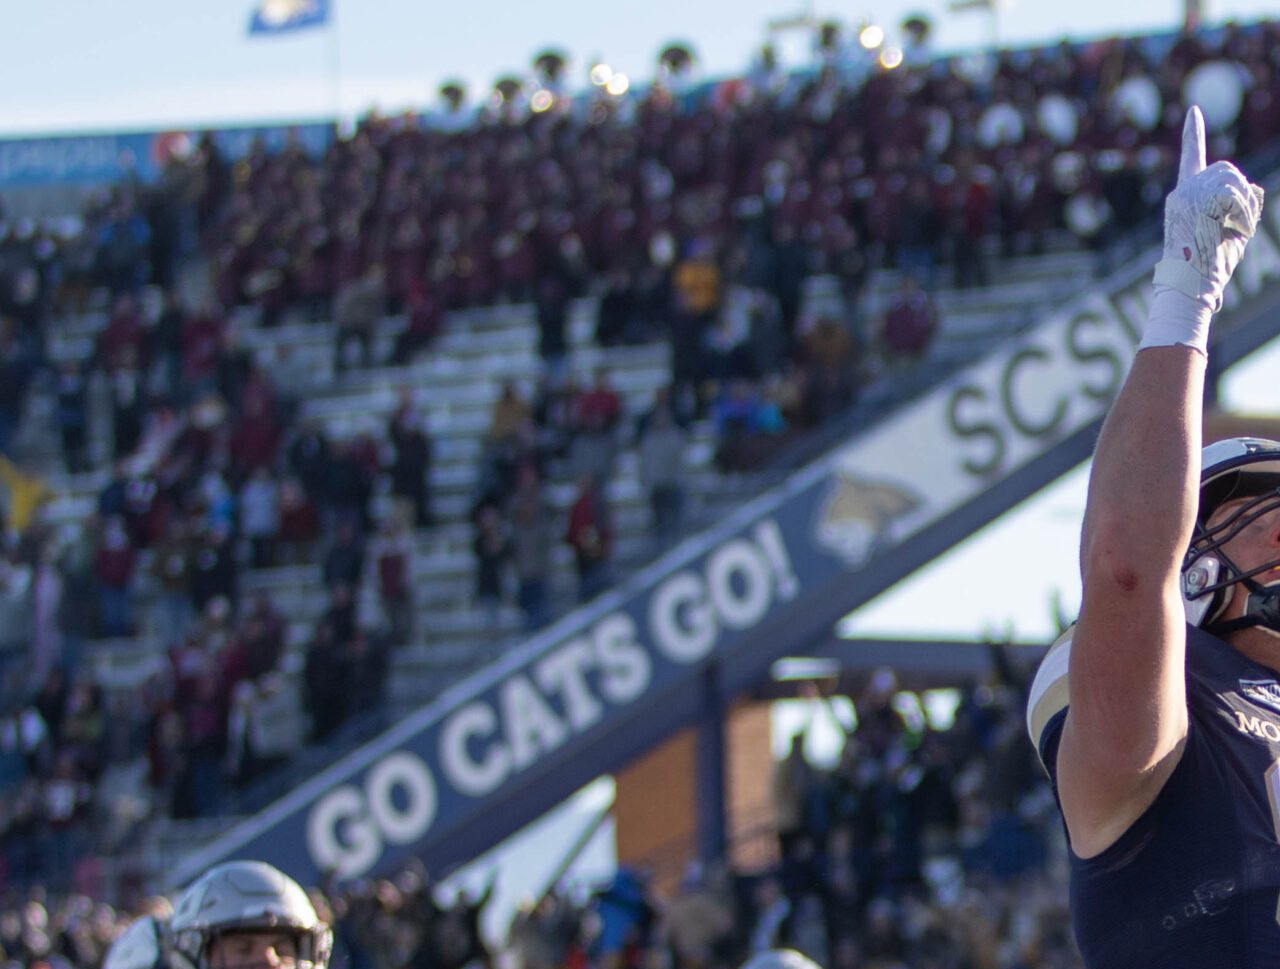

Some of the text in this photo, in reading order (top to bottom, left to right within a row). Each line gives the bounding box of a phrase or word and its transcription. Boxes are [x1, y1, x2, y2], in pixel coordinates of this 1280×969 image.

[307, 519, 798, 880] GO CATS GO!
